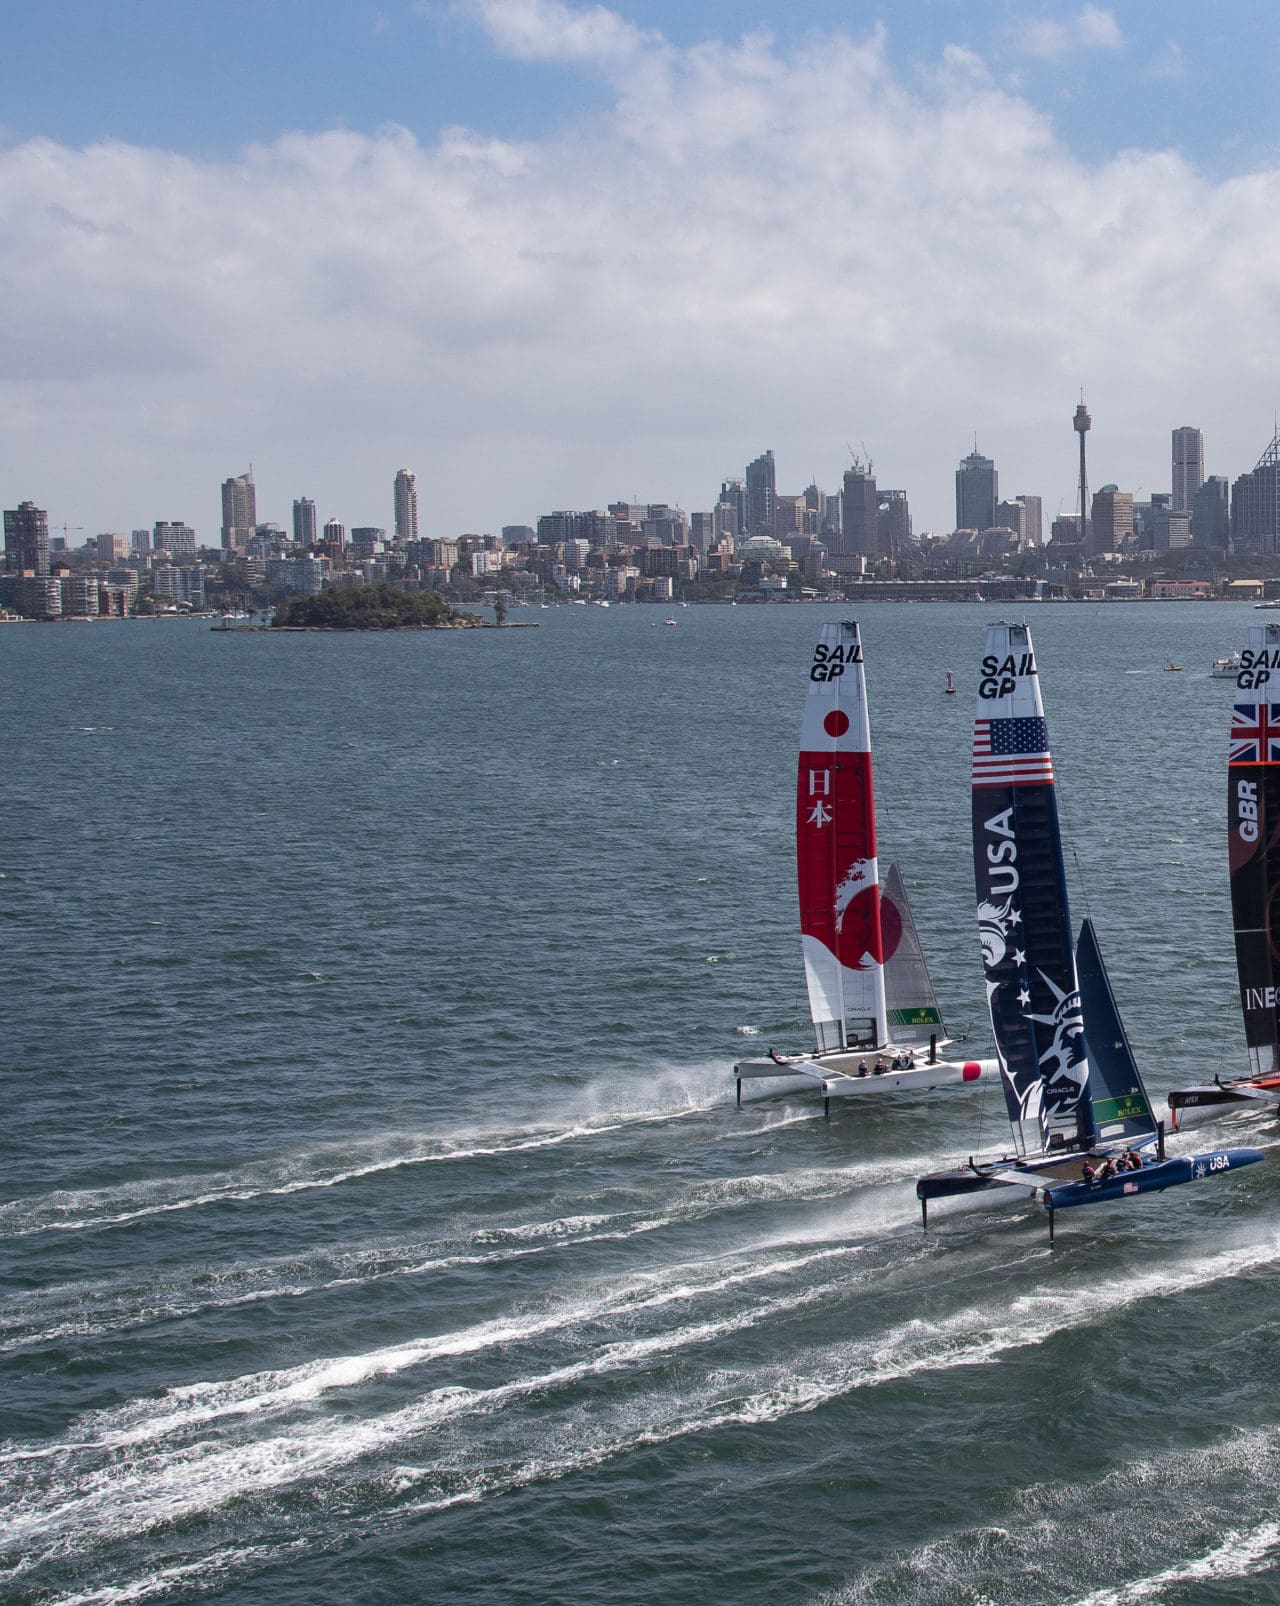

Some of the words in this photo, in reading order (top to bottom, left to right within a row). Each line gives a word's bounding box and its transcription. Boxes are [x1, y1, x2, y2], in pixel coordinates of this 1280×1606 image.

[814, 644, 864, 664] SAIL
[810, 664, 845, 682] GP
[981, 653, 1037, 677] SAIL
[979, 678, 1016, 699] GP
[1237, 670, 1270, 689] GP
[806, 769, 832, 828] 日本
[1237, 780, 1259, 842] GBR
[984, 807, 1019, 894] USA
[1046, 1087, 1076, 1095] ORACLE
[1117, 1107, 1141, 1117] ROLEX
[1210, 1155, 1230, 1171] USA
